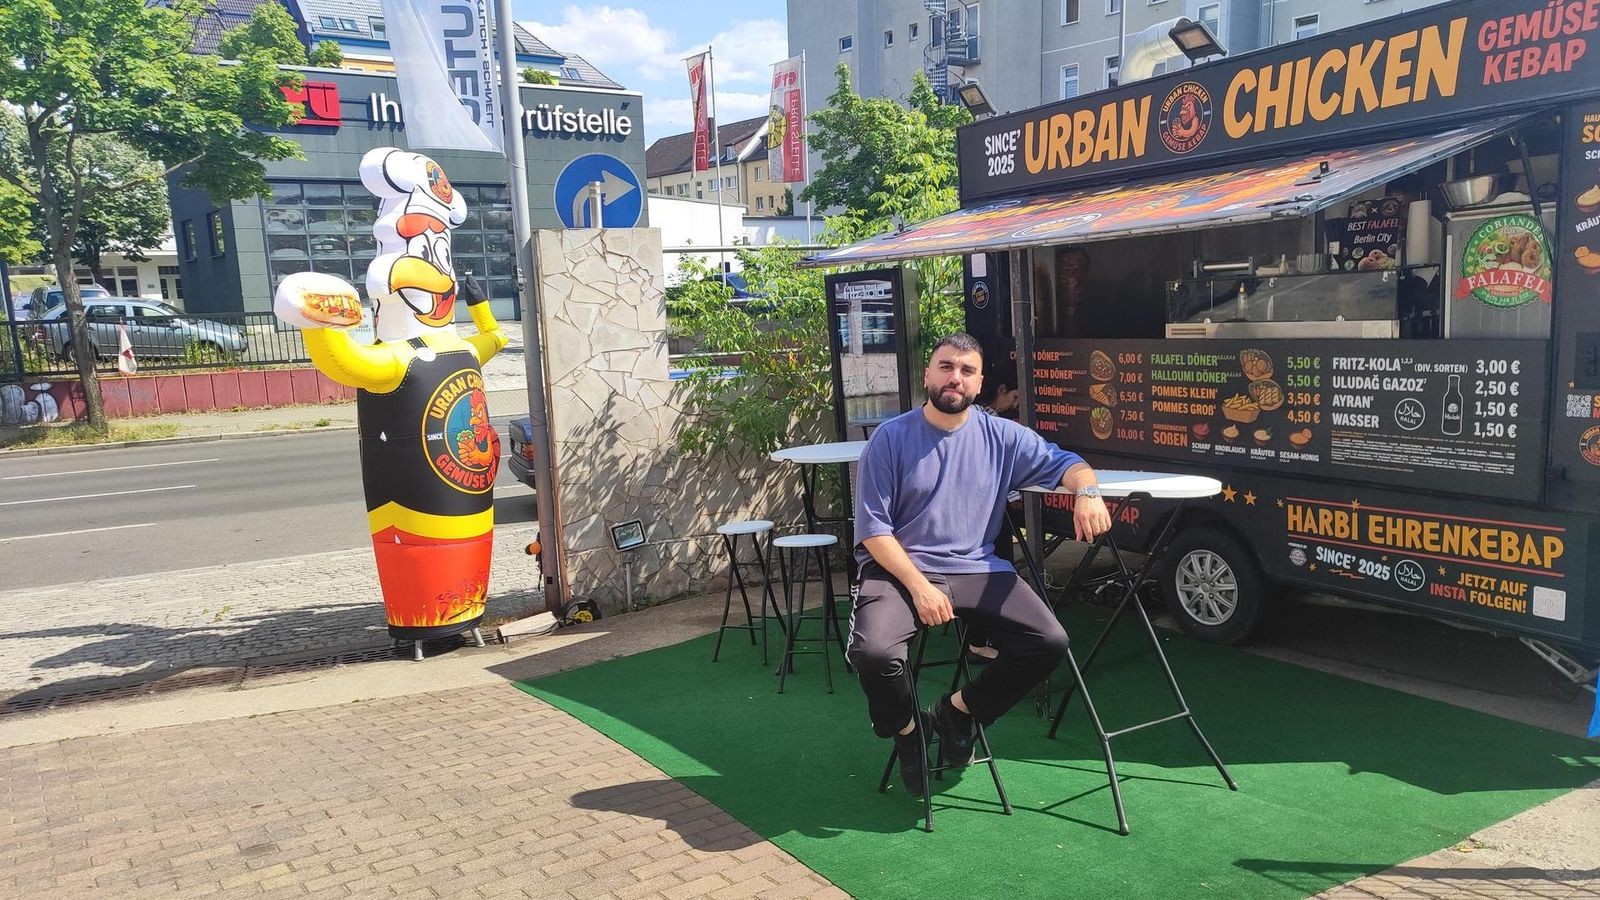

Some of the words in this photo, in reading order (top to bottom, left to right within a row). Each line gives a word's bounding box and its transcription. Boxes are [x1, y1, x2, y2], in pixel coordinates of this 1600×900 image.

[1478, 0, 1600, 52] GEMÜSE
[1483, 39, 1586, 86] KEBAP
[1024, 95, 1152, 175] URBAN
[1223, 17, 1468, 139] CHICKEN
[1162, 87, 1183, 113] URBAN
[1183, 84, 1209, 104] CHICKEN
[371, 92, 400, 123] Ih
[988, 154, 1015, 177] 2025
[1347, 220, 1367, 231] BEST
[1575, 214, 1600, 233] KRÄU
[1354, 234, 1375, 244] Berlin
[1376, 232, 1392, 243] City
[1467, 271, 1545, 293] FALAFEL
[1118, 353, 1136, 365] 6,00
[1137, 354, 1142, 364] €
[1151, 353, 1186, 366] FALAFEL
[1187, 352, 1218, 366] DÖNER
[1287, 356, 1311, 370] 5,50
[1313, 357, 1321, 369] €
[1434, 363, 1468, 374] SORTEN)
[1475, 359, 1508, 376] 3,00
[1511, 360, 1520, 375] €
[1119, 372, 1136, 384] 7,00
[1137, 373, 1143, 383] €
[1151, 369, 1194, 382] HALLOUMI
[1196, 368, 1227, 384] DÖNER
[1287, 375, 1311, 388] 5,50
[1313, 376, 1321, 387] €
[429, 376, 467, 419] URBAN
[1119, 392, 1137, 403] 6,50
[1138, 393, 1144, 402] €
[1152, 385, 1188, 398] POMMES
[1287, 393, 1311, 406] 3,50
[1313, 394, 1321, 406] €
[1475, 380, 1506, 397] 2,50
[1509, 381, 1519, 396] €
[1120, 410, 1138, 422] 7,50
[1139, 411, 1144, 421] €
[1152, 401, 1188, 414] POMMES
[1287, 410, 1311, 425] 4,50
[1313, 411, 1321, 424] €
[1475, 401, 1505, 418] 1,50
[1508, 402, 1518, 417] €
[1117, 428, 1137, 441] 10,00
[1139, 430, 1145, 440] €
[1332, 412, 1379, 428] WASSER
[1474, 421, 1504, 438] 1,50
[1507, 423, 1517, 438] €
[427, 432, 444, 441] SINCE
[1214, 445, 1246, 454] KNOBLAUCH
[1368, 514, 1565, 569] EHRENKEBAP
[1357, 558, 1391, 581] 2025
[1457, 572, 1497, 591] JETZT
[1500, 579, 1528, 597] AUF
[1430, 582, 1467, 602] INSTA
[1469, 590, 1527, 614] FOLGEN!
